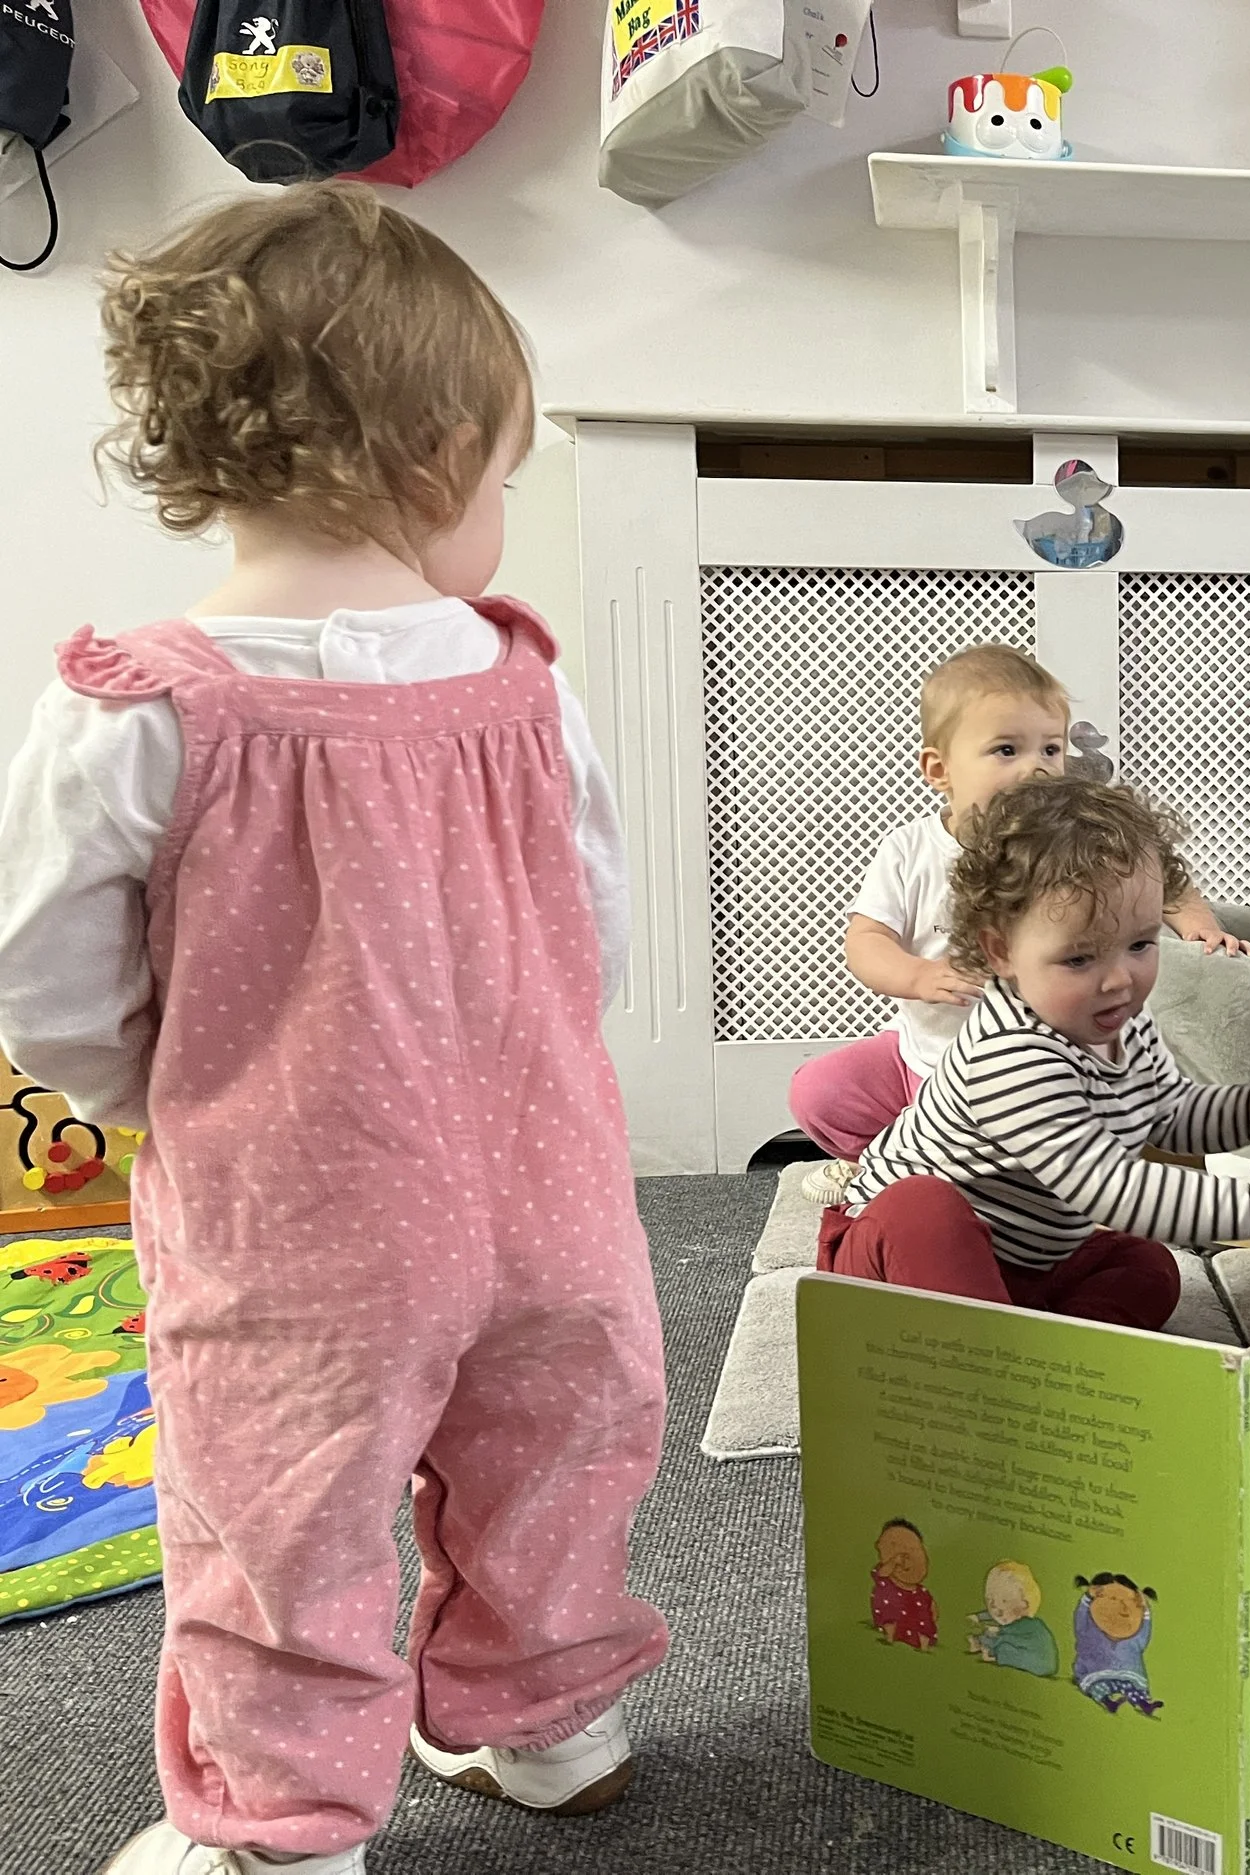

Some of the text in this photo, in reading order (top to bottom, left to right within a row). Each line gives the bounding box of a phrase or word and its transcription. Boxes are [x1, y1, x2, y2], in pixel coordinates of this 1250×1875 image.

[2, 4, 75, 48] PEUGEOT
[627, 6, 651, 40] Bag
[1112, 1832, 1135, 1854] CE
